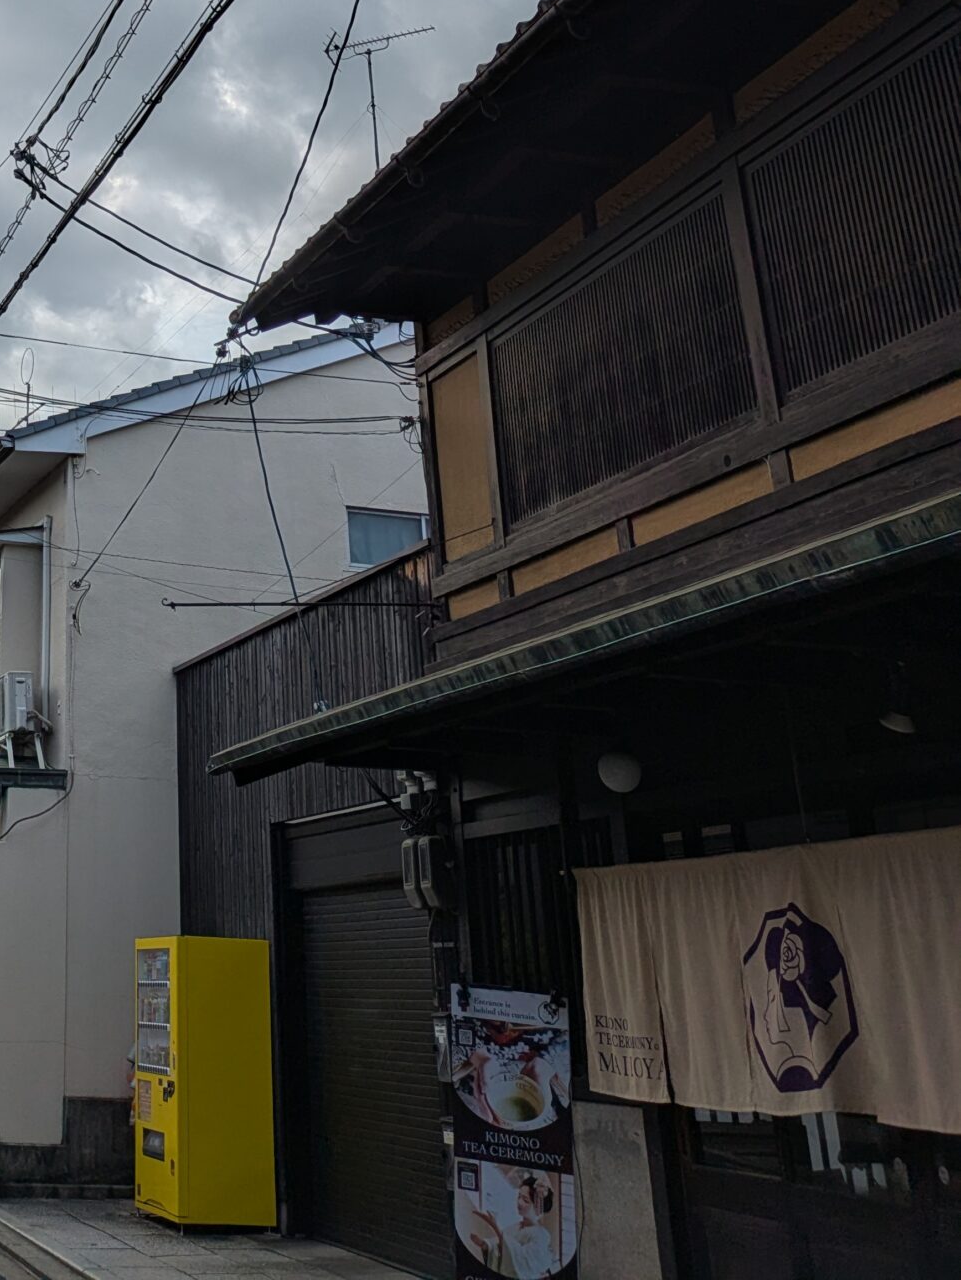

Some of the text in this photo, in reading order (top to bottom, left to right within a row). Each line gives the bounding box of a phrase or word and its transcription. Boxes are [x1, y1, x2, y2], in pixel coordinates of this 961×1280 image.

[473, 997, 504, 1007] Entrance
[474, 1007, 496, 1016] behind
[497, 1009, 510, 1017] this
[595, 1015, 628, 1031] KIONO
[485, 1131, 541, 1150] KIMONO
[462, 1141, 487, 1155] TEA
[489, 1146, 564, 1167] CEREMONY
